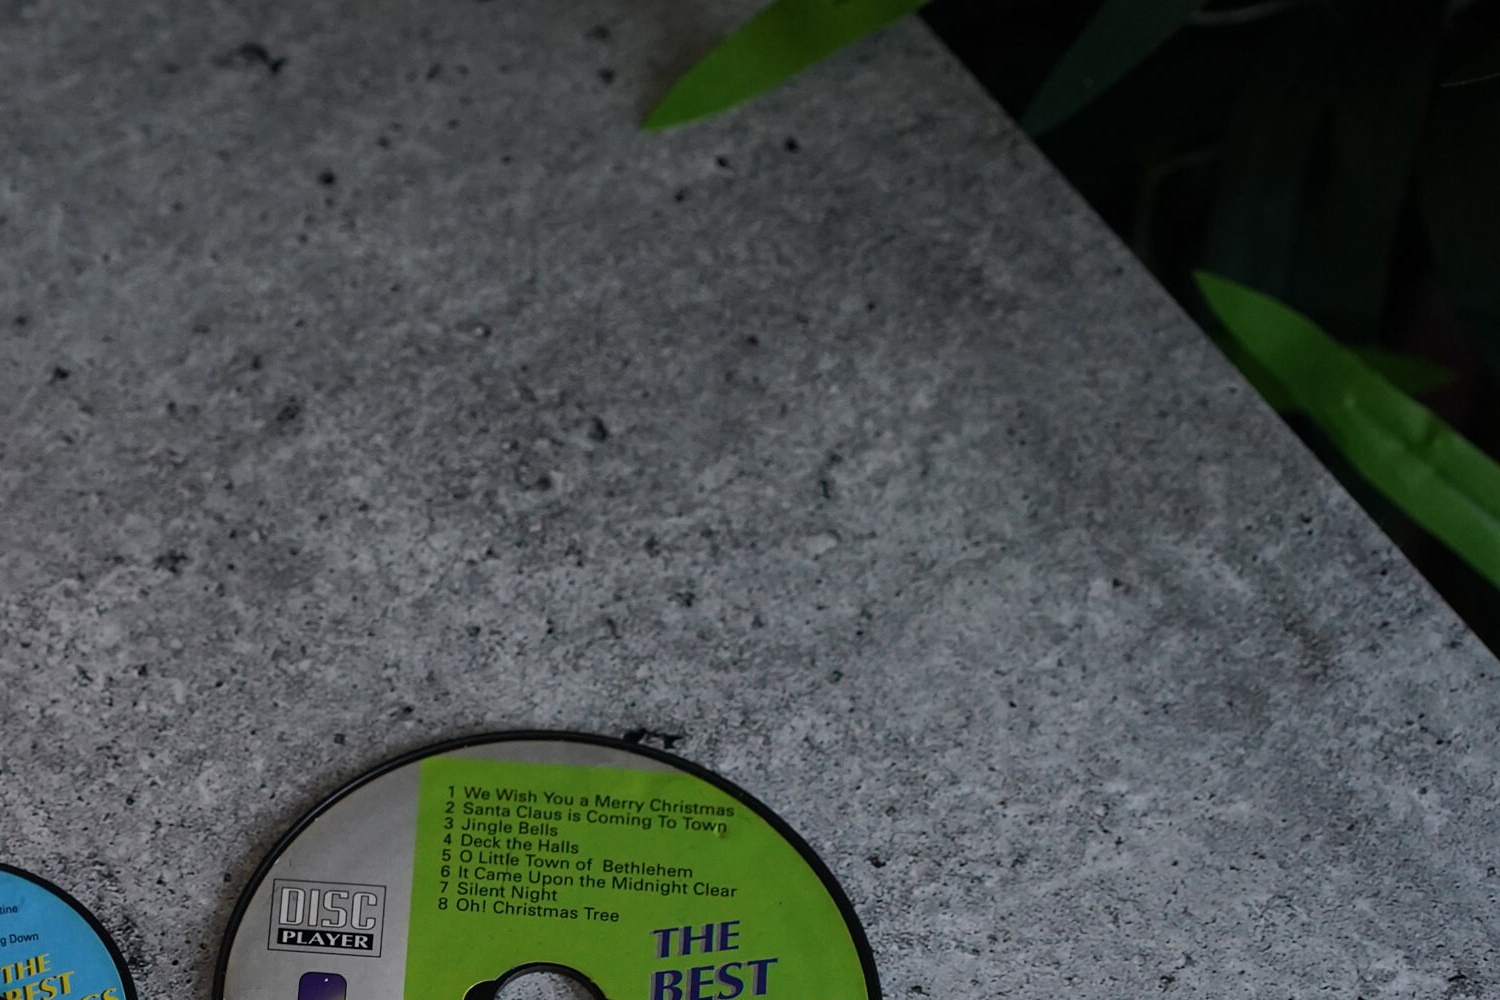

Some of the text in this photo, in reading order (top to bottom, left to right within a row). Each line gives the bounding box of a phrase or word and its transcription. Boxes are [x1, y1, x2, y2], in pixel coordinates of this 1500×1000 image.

[443, 832, 579, 855] 4 Deck the Halls
[439, 880, 558, 903] 7 Silent Night
[278, 886, 378, 930] DISC
[437, 897, 620, 923] 8 Oh! Christmas Tree
[282, 930, 369, 949] PLAYER
[650, 920, 740, 959] THE
